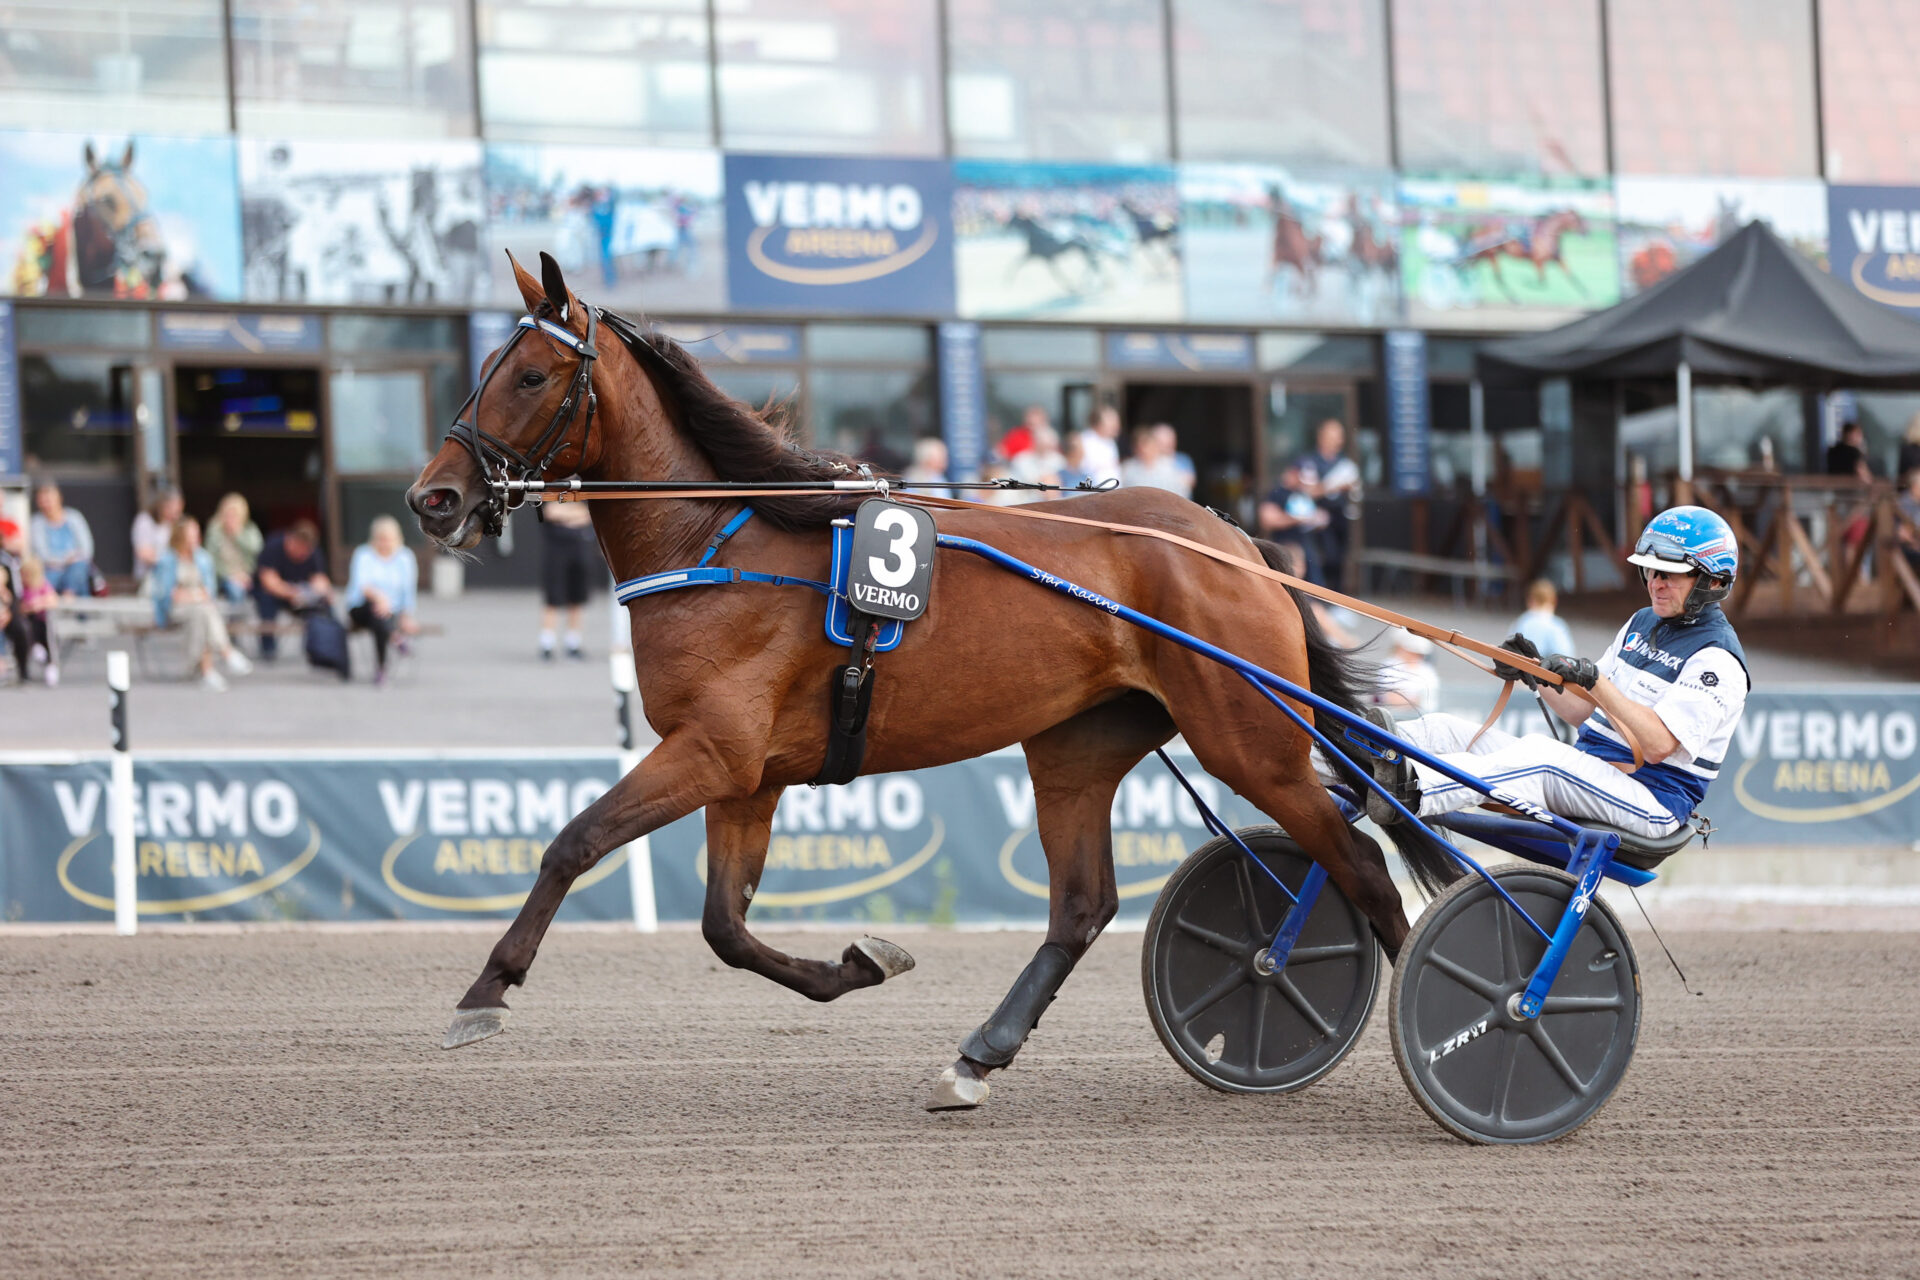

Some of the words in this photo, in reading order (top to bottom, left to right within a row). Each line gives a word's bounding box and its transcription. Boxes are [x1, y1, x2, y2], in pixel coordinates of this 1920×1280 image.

[743, 180, 922, 231] VERMO
[868, 508, 919, 588] 3
[854, 583, 920, 611] VERMO
[1030, 568, 1064, 588] Star
[1067, 583, 1121, 614] Racing
[1735, 710, 1918, 761] VERMO
[1773, 760, 1893, 793] AREENA
[771, 774, 925, 832] RMO
[994, 773, 1220, 829] VMO
[111, 841, 265, 878] REENA
[433, 838, 553, 875] AREEN
[1111, 830, 1189, 867] ENA
